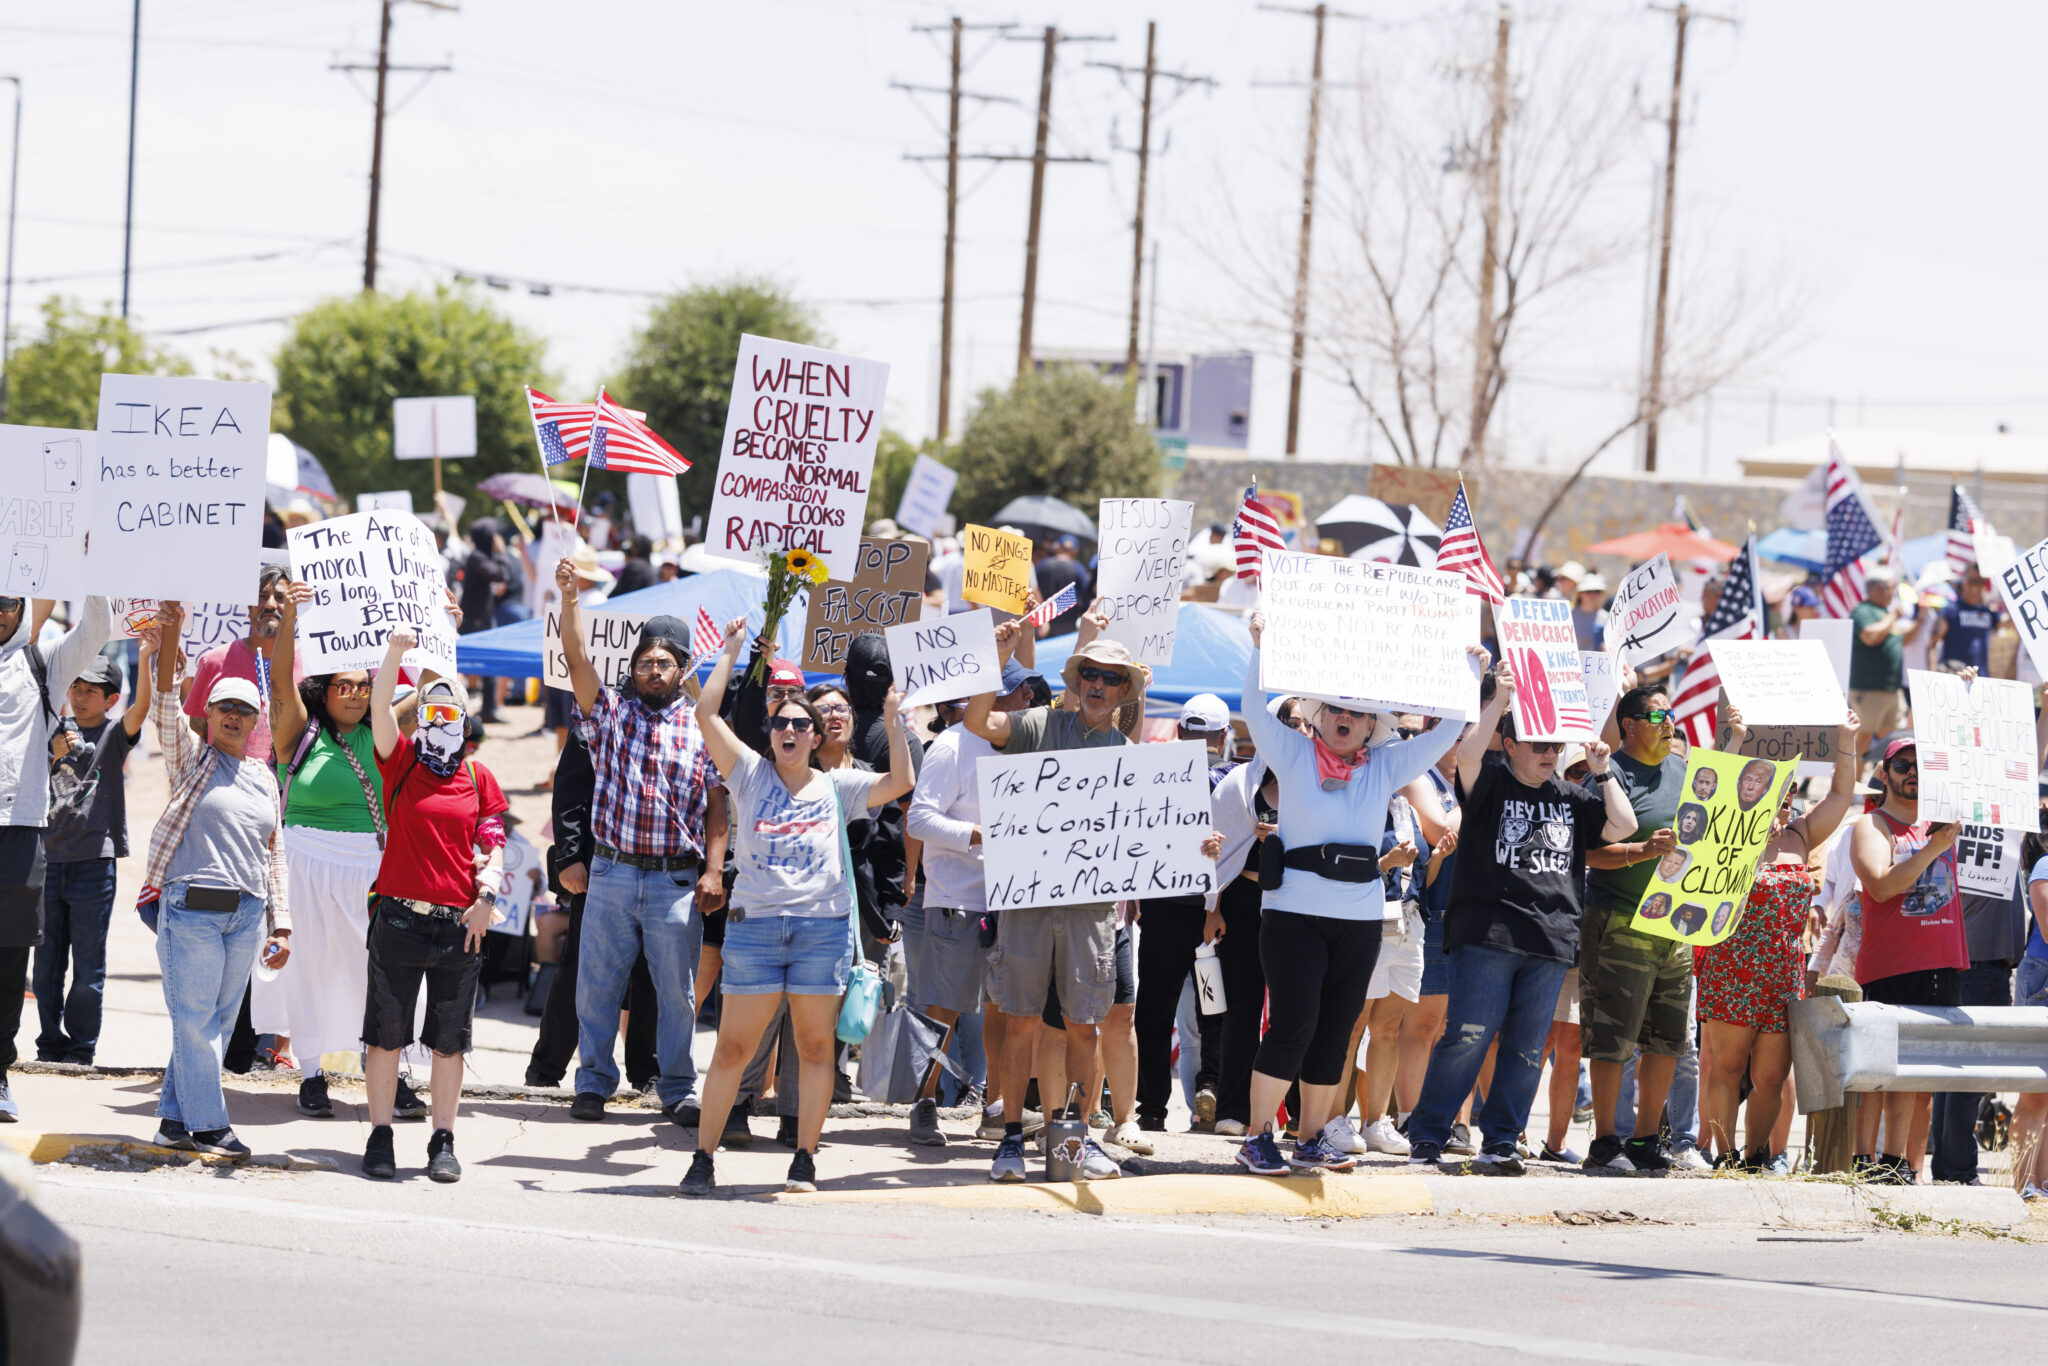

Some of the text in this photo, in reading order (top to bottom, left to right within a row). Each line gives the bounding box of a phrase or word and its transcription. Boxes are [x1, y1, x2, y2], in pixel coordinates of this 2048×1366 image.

[752, 354, 850, 397] WHEN
[111, 402, 242, 437] IKEA
[753, 395, 874, 443] CRUELTY
[733, 428, 828, 464] BECOMES
[100, 456, 244, 482] has a better
[785, 462, 866, 493] NORMAL
[720, 472, 828, 505] COMPASSION
[0, 496, 74, 538] ABLE
[117, 501, 246, 532] CABINET
[366, 516, 404, 541] Arc
[787, 503, 846, 527] LOOKS
[1102, 499, 1172, 531] JESUS
[726, 515, 832, 554] RADICAL
[971, 531, 1029, 561] NO KINGS
[1099, 534, 1161, 561] LOVE
[301, 551, 368, 582] moral
[854, 543, 912, 583] TOP
[1268, 552, 1462, 590] VOTE THE REPUBLICANS
[2002, 541, 2048, 600] ELEC
[313, 579, 437, 606] is long, but it
[966, 569, 1028, 601] NO MASTERS
[1271, 577, 1304, 592] OUT
[1309, 582, 1327, 593] OF
[1334, 582, 1390, 597] OFFICE!
[1432, 592, 1460, 606] THE
[360, 602, 431, 627] BENDS
[1104, 594, 1172, 622] DEPORT
[1269, 593, 1355, 611] REPUBLICAN
[1364, 600, 1407, 617] PARTY
[1408, 604, 1460, 622] TRUMP
[1511, 599, 1570, 621] DEFEND
[1624, 582, 1680, 631] EDUCATION
[591, 618, 645, 649] HUM
[1268, 613, 1450, 640] WOULD NOT BE ABLE
[1502, 621, 1574, 643] DEMOCRACY
[1271, 632, 1466, 661] TO DO ALL THAT HE HAS
[1546, 650, 1579, 669] KINGS
[549, 650, 569, 678] IS
[905, 653, 980, 690] KINGS
[1506, 647, 1557, 736] NO
[1551, 689, 1586, 704] TYRANTS
[1921, 675, 1959, 712] YOU
[1912, 708, 1959, 747] LOVE
[990, 757, 1194, 800] The People and
[1960, 750, 1997, 781] BUT
[989, 796, 1211, 838] the Constitution
[1704, 804, 1771, 846] KING
[1065, 835, 1149, 864] Rule
[1495, 839, 1520, 868] WE
[1717, 846, 1742, 866] OF
[1957, 839, 2003, 869] FF!
[988, 859, 1212, 908] Not a Mad King
